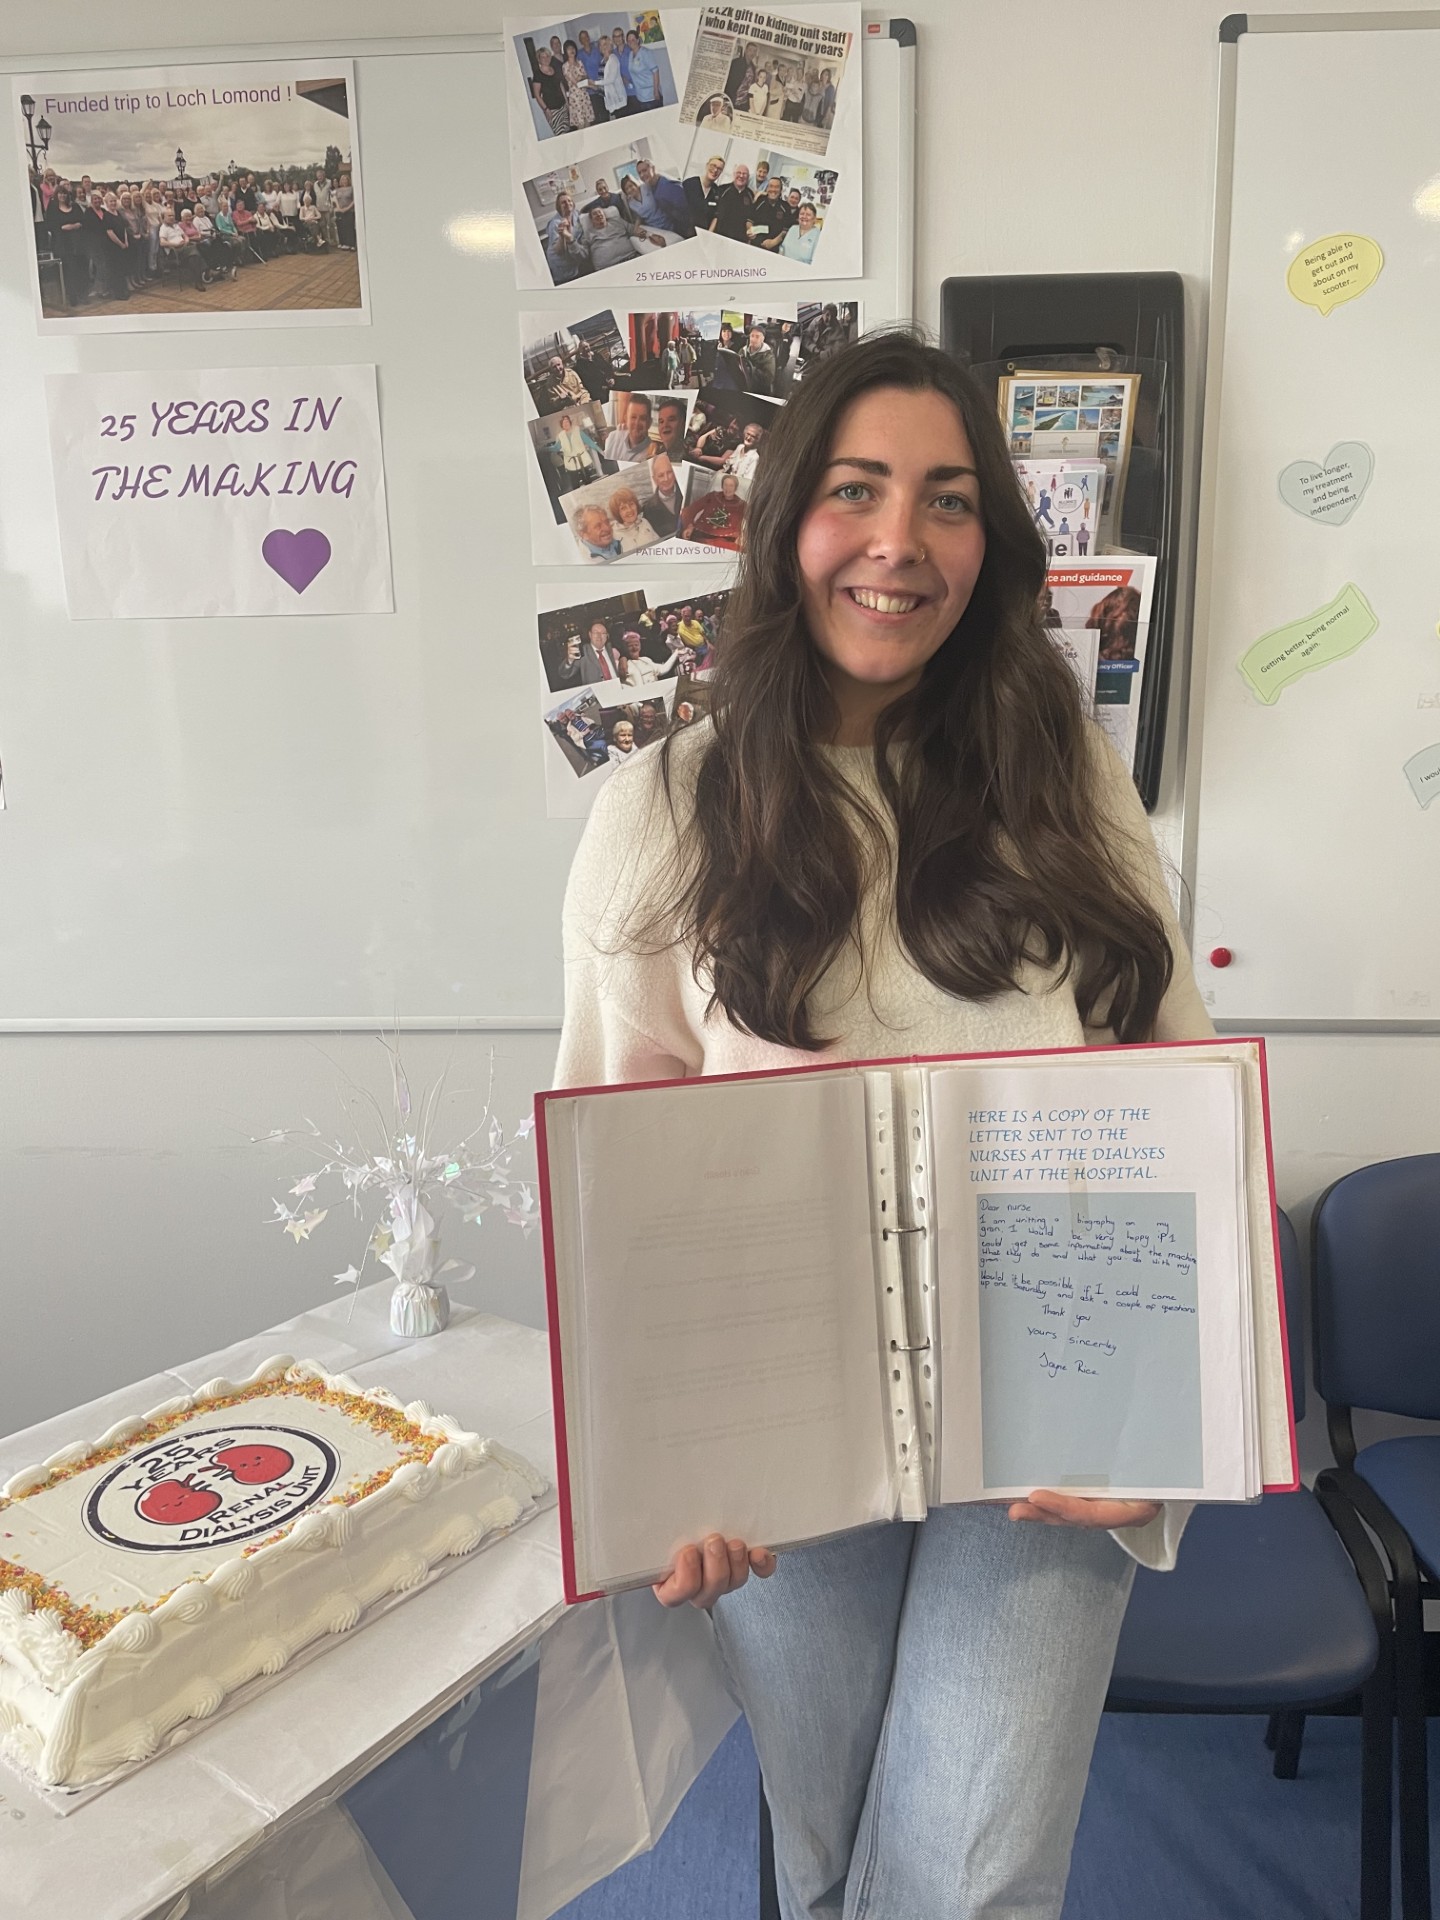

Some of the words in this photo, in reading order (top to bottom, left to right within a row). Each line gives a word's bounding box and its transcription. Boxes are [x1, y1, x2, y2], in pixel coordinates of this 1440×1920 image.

[705, 15, 725, 30] who
[726, 20, 749, 36] kept
[750, 26, 773, 42] man
[773, 31, 798, 48] alive
[799, 38, 815, 52] for
[814, 42, 844, 58] years
[735, 9, 753, 22] gift
[754, 11, 764, 25] to
[766, 15, 799, 36] kidney
[800, 26, 821, 40] unit
[821, 31, 847, 44] staff
[45, 95, 109, 114] Funded
[114, 94, 141, 114] trip
[146, 94, 161, 109] to
[166, 89, 207, 107] Loch
[212, 85, 281, 105] Lomond
[1304, 251, 1326, 266] Being
[1327, 245, 1343, 257] able
[1344, 241, 1353, 250] to
[1311, 265, 1323, 277] get
[1324, 260, 1338, 270] out
[1339, 252, 1354, 264] and
[636, 272, 647, 282] 25
[649, 270, 682, 281] YEARS
[684, 270, 698, 280] OF
[700, 267, 767, 279] FUNDRAISING
[1313, 273, 1336, 287] about
[1336, 268, 1347, 278] on
[1347, 262, 1359, 272] my
[100, 414, 137, 442] 25
[151, 398, 270, 437] YEARS
[283, 396, 342, 433] IN
[91, 464, 172, 501] THE
[177, 460, 358, 499] MAKING
[1299, 477, 1309, 485] To
[1310, 472, 1323, 481] live
[1323, 462, 1350, 476] longer,
[1303, 488, 1314, 496] my
[1315, 472, 1353, 491] treatment
[1310, 493, 1357, 516] independent
[1312, 493, 1327, 504] and
[1328, 485, 1349, 498] being
[636, 547, 674, 556] PATIENT
[676, 546, 700, 555] DAYS
[1060, 573, 1078, 582] and
[1079, 573, 1122, 584] guidance
[1260, 653, 1286, 674] Getting
[1284, 638, 1307, 656] better,
[1306, 623, 1327, 640] being
[1326, 605, 1350, 626] normal
[968, 1110, 1007, 1124] HERE
[1011, 1110, 1027, 1122] IS
[1032, 1110, 1043, 1122] A
[1048, 1109, 1089, 1122] COPY
[1093, 1108, 1115, 1122] OF
[1119, 1108, 1151, 1121] THE
[969, 1129, 1022, 1143] LETTER
[1027, 1128, 1066, 1142] SENT
[1071, 1128, 1093, 1141] TO
[1097, 1128, 1128, 1141] THE
[969, 1149, 1026, 1162] NURSES
[1031, 1149, 1053, 1161] AT
[1057, 1148, 1087, 1162] THE
[1092, 1147, 1165, 1161] DIALYSES
[970, 1168, 1009, 1182] UNIT
[1013, 1168, 1034, 1181] AT
[1038, 1168, 1070, 1181] THE
[1074, 1166, 1157, 1181] HOSPITAL.
[980, 1199, 999, 1211] Dear
[1007, 1204, 1031, 1212] nurse
[980, 1214, 986, 1224] I
[1077, 1212, 1115, 1235] biography
[1156, 1222, 1169, 1236] my
[981, 1237, 1003, 1247] could
[1014, 1241, 1027, 1252] get
[1068, 1241, 1112, 1250] information
[1120, 1245, 1140, 1257] about
[1149, 1244, 1162, 1257] the
[1071, 1230, 1082, 1240] be
[1095, 1233, 1114, 1249] very
[1126, 1230, 1150, 1248] happy
[1031, 1248, 1040, 1257] do
[1052, 1251, 1068, 1259] and
[1107, 1255, 1121, 1265] you
[1152, 1258, 1170, 1266] with
[1177, 1263, 1190, 1275] my
[981, 1270, 1003, 1281] Would
[1012, 1274, 1018, 1283] it
[1021, 1272, 1031, 1285] be
[1038, 1277, 1073, 1290] possible
[1084, 1285, 1091, 1299] if
[1095, 1282, 1104, 1294] I
[1116, 1284, 1139, 1296] could
[981, 1281, 990, 1289] up
[1057, 1291, 1073, 1299] and
[1116, 1300, 1141, 1310] couple
[1161, 1304, 1196, 1314] questions
[1042, 1303, 1065, 1316] Thank
[1073, 1314, 1091, 1328] you
[1027, 1326, 1057, 1339] Yours
[1039, 1351, 1067, 1378] Jayne
[1075, 1360, 1099, 1375] Rice
[117, 1437, 236, 1491] YEARS
[139, 1444, 195, 1474] 25
[179, 1498, 293, 1542] DIALYSIS
[284, 1465, 321, 1500] UNIT
[207, 1481, 295, 1524] RENAL
